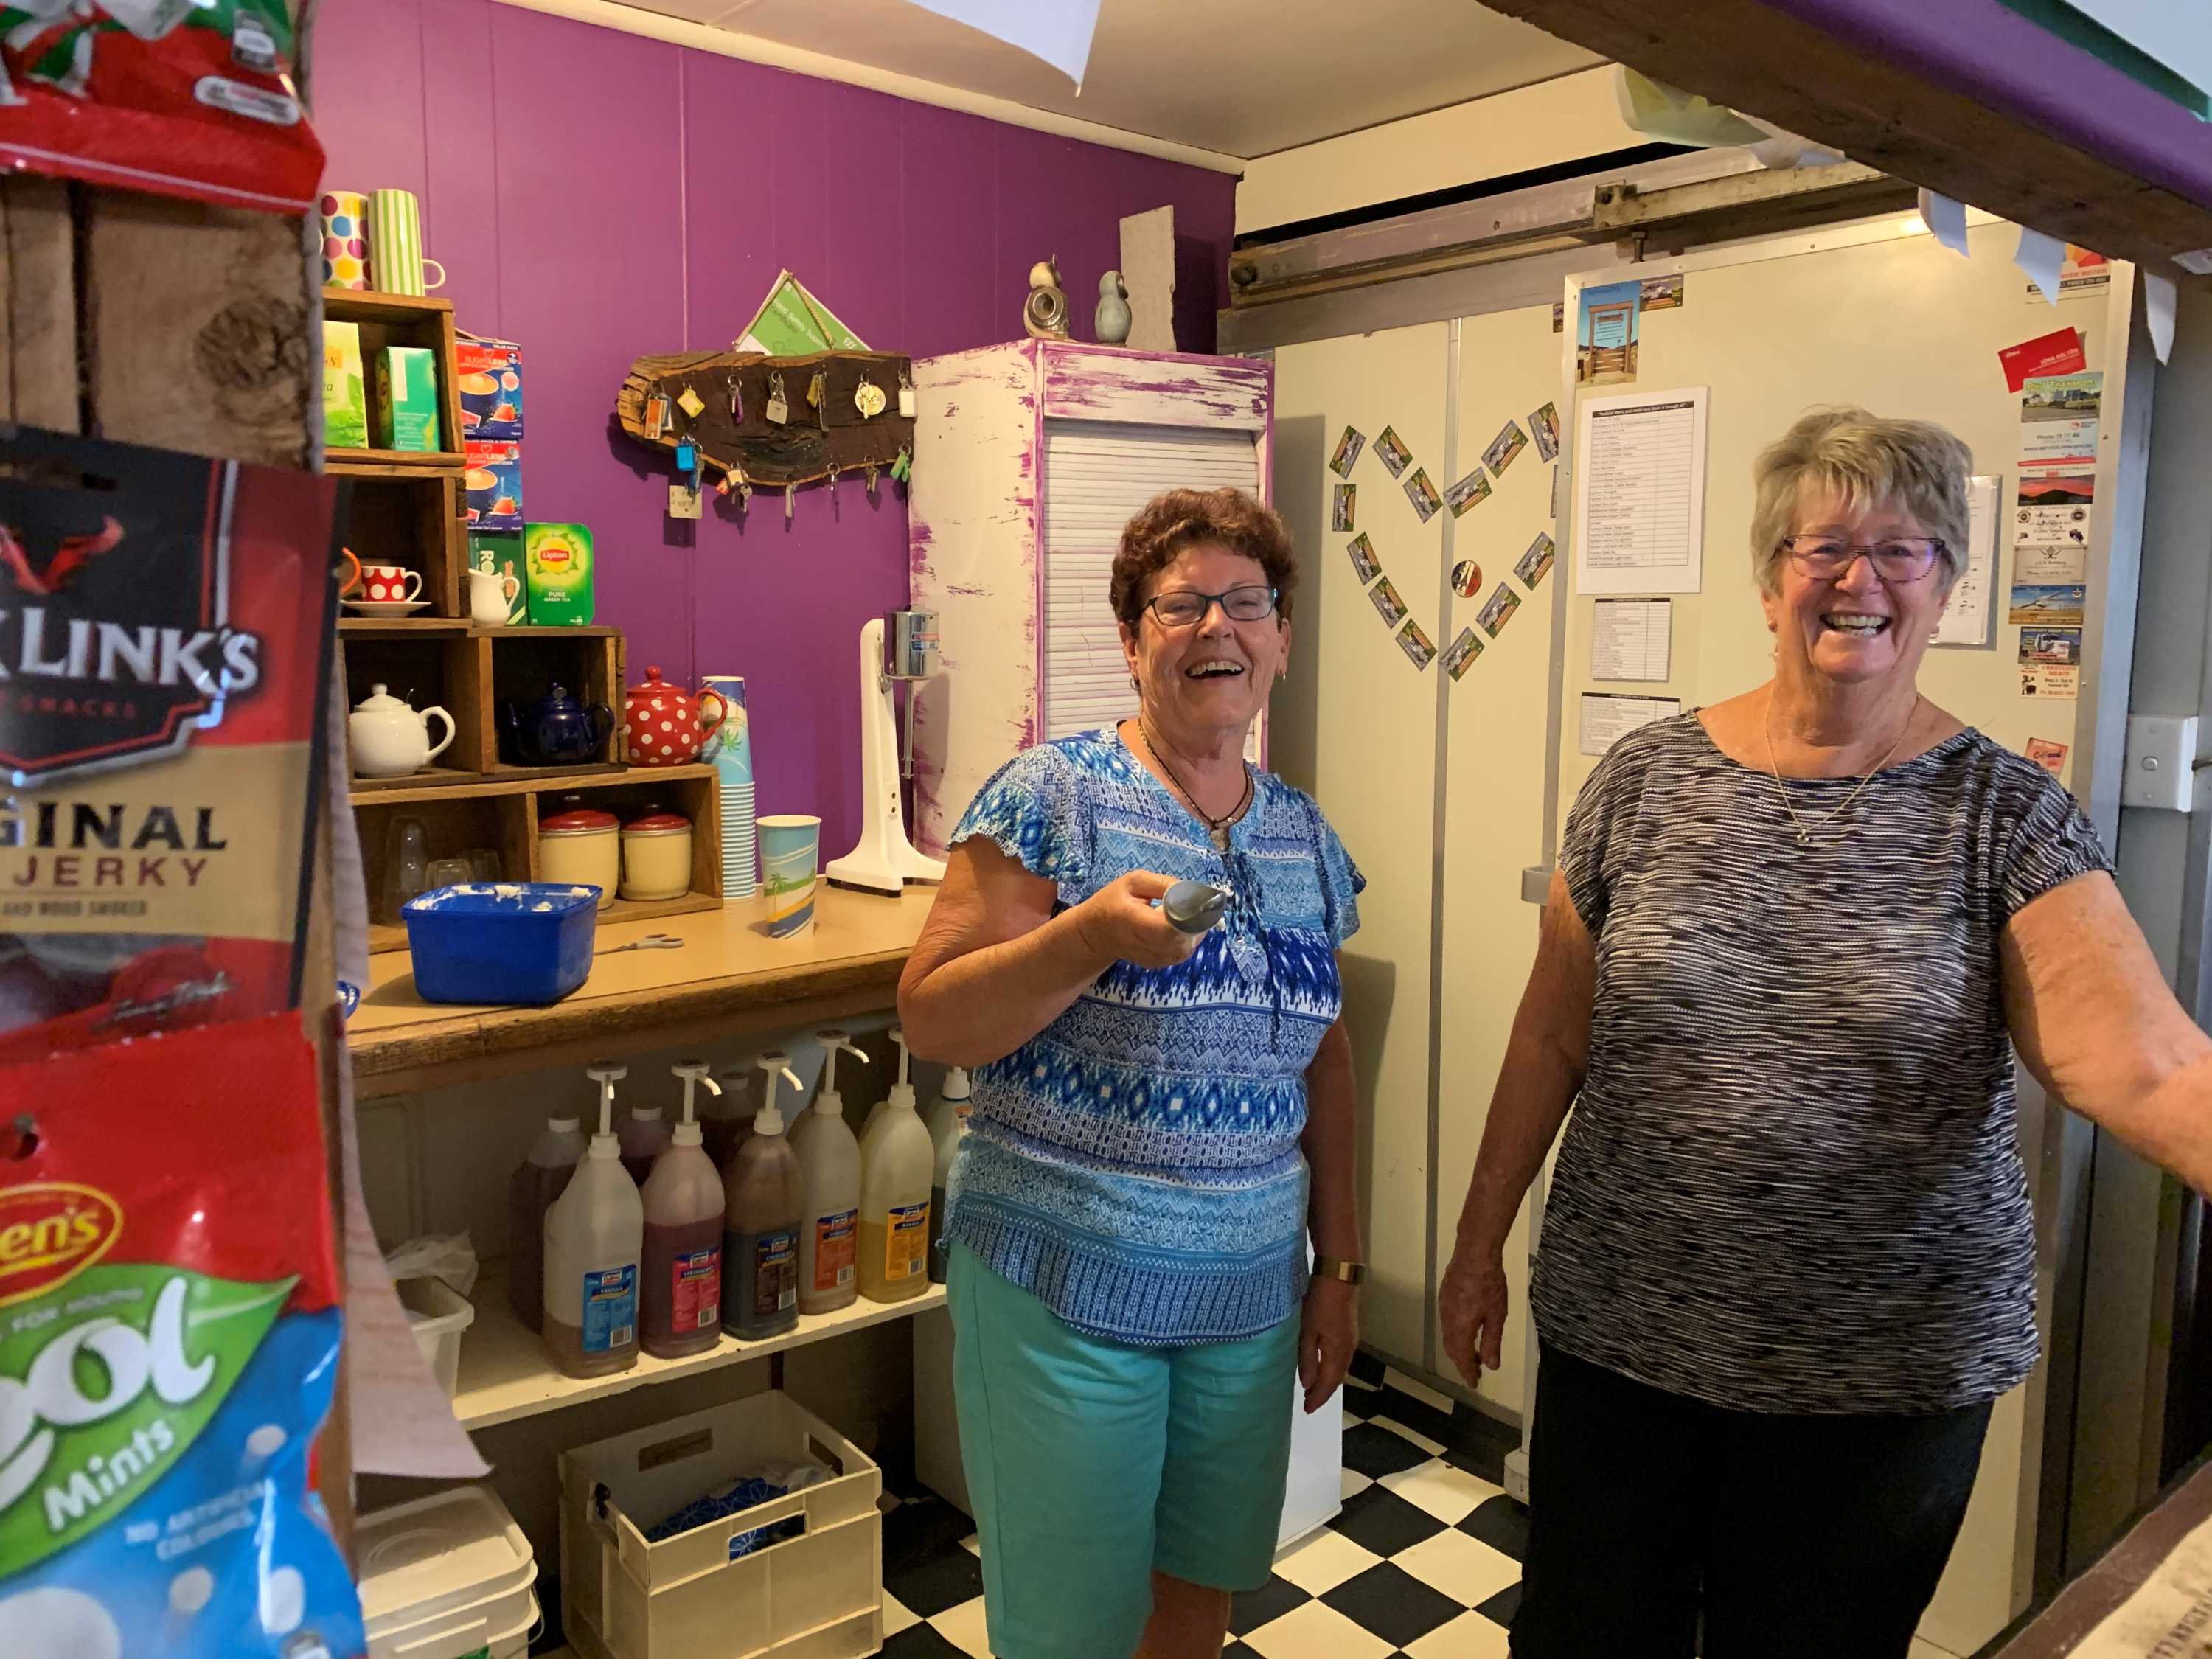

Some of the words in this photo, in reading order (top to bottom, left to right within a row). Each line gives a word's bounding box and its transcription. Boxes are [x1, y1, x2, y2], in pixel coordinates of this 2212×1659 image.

[542, 550, 568, 560] Lipton
[19, 607, 259, 695] LINK'S
[13, 855, 208, 887] JERKY
[43, 1419, 174, 1532] Mints
